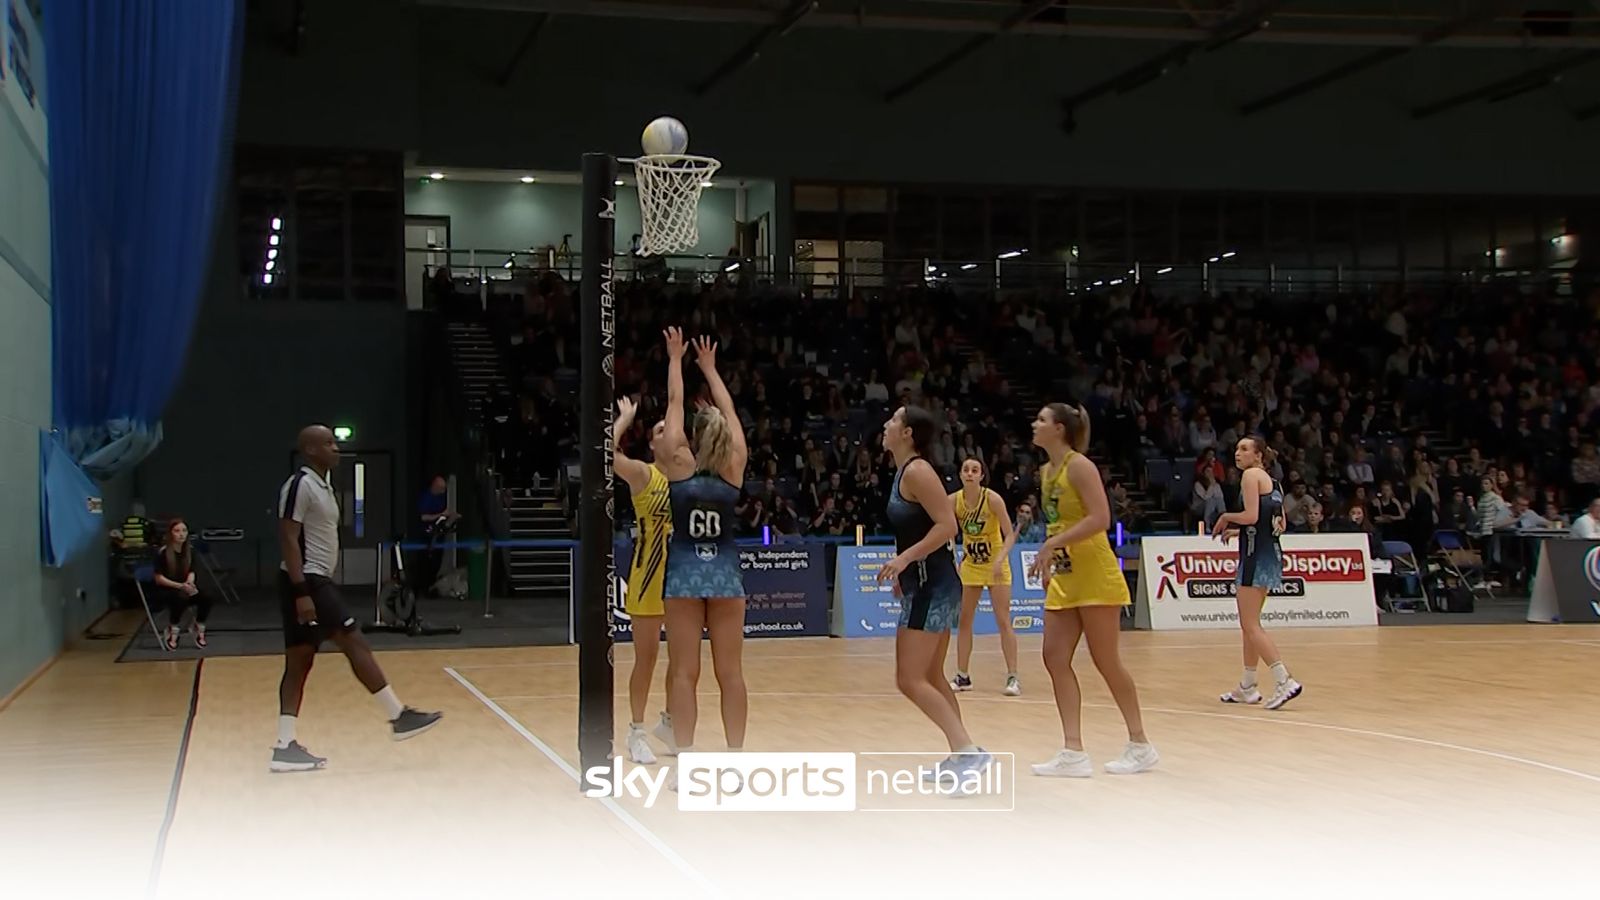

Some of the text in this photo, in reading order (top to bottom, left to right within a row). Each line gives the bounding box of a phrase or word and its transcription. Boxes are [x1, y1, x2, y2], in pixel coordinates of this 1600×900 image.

[601, 258, 612, 348] NETBALL
[689, 509, 720, 538] GD
[758, 550, 808, 560] independent
[753, 560, 772, 570] boys
[774, 560, 789, 568] and
[791, 560, 808, 570] girls
[1180, 554, 1240, 574] Univer
[1282, 553, 1352, 575] Display
[1192, 583, 1228, 595] SIGNS
[743, 622, 804, 634] gsschool.co.uk
